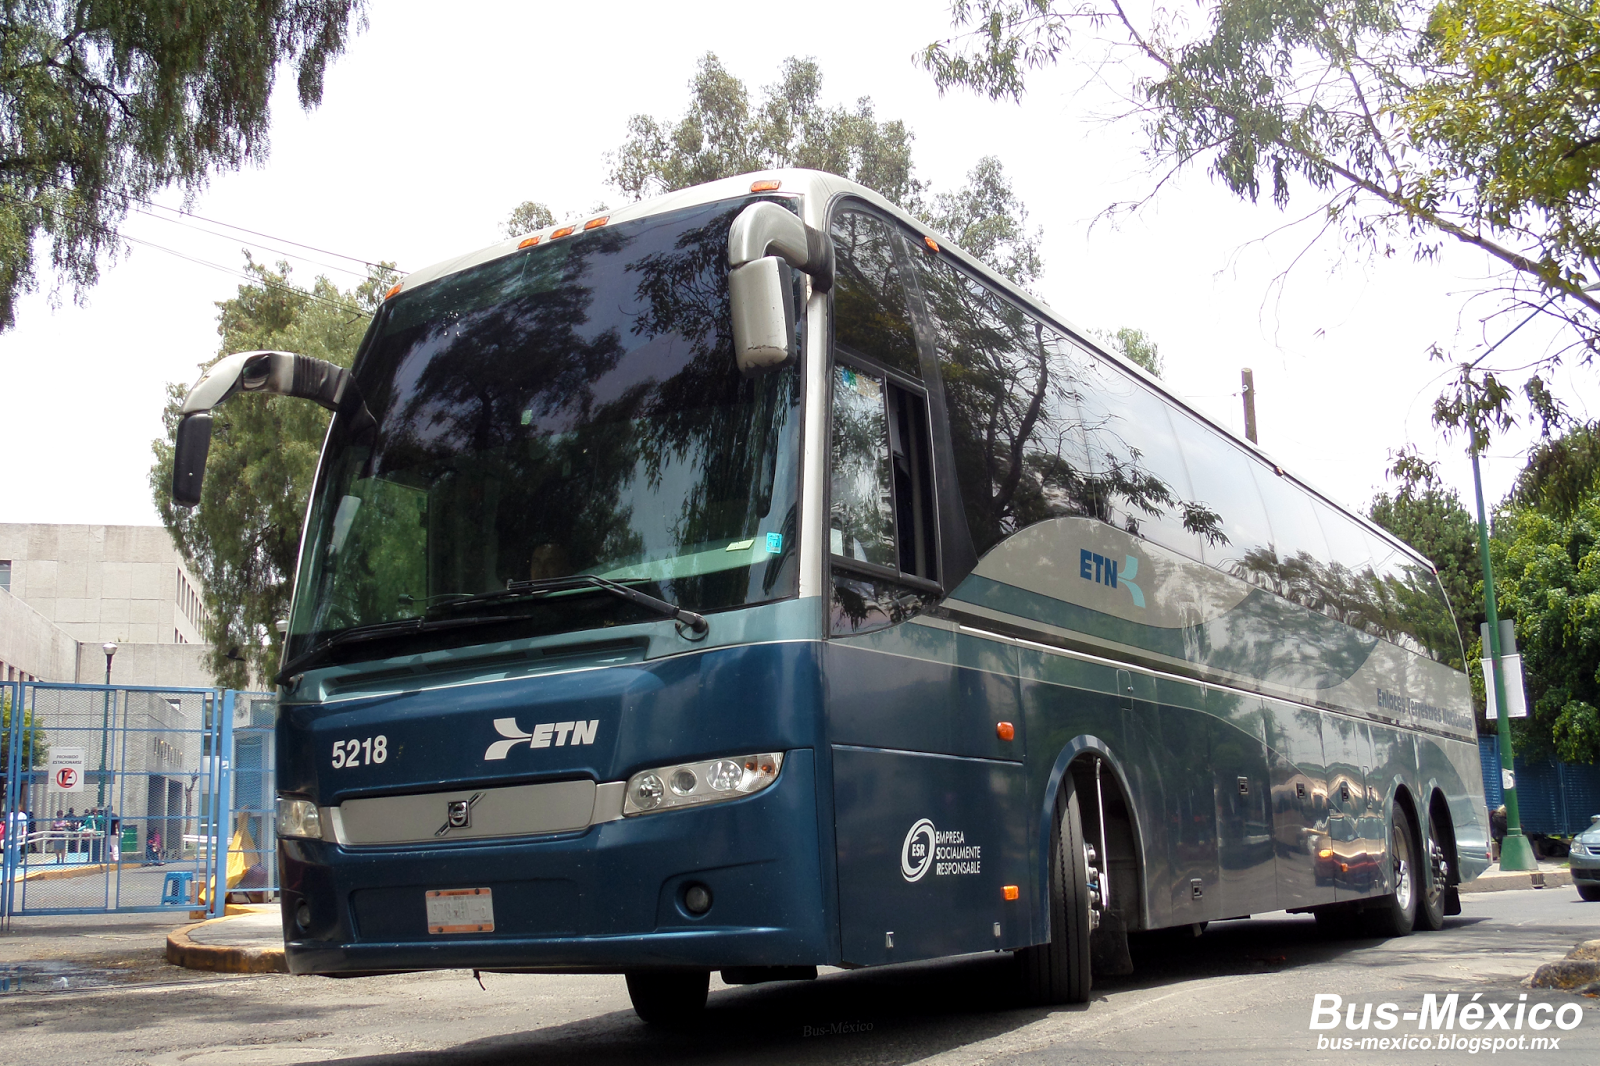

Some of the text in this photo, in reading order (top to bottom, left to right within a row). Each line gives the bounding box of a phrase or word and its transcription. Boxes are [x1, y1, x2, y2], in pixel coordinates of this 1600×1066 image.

[1080, 548, 1118, 589] ETN
[1377, 688, 1406, 714] Enlaces
[1406, 697, 1442, 723] Terrestres
[530, 719, 599, 749] ETN
[332, 735, 388, 769] 5218
[935, 830, 965, 844] EMPRESA
[911, 843, 926, 857] ESR
[935, 846, 981, 860] SOCIALMENTE
[936, 861, 981, 876] RESPONSABLE
